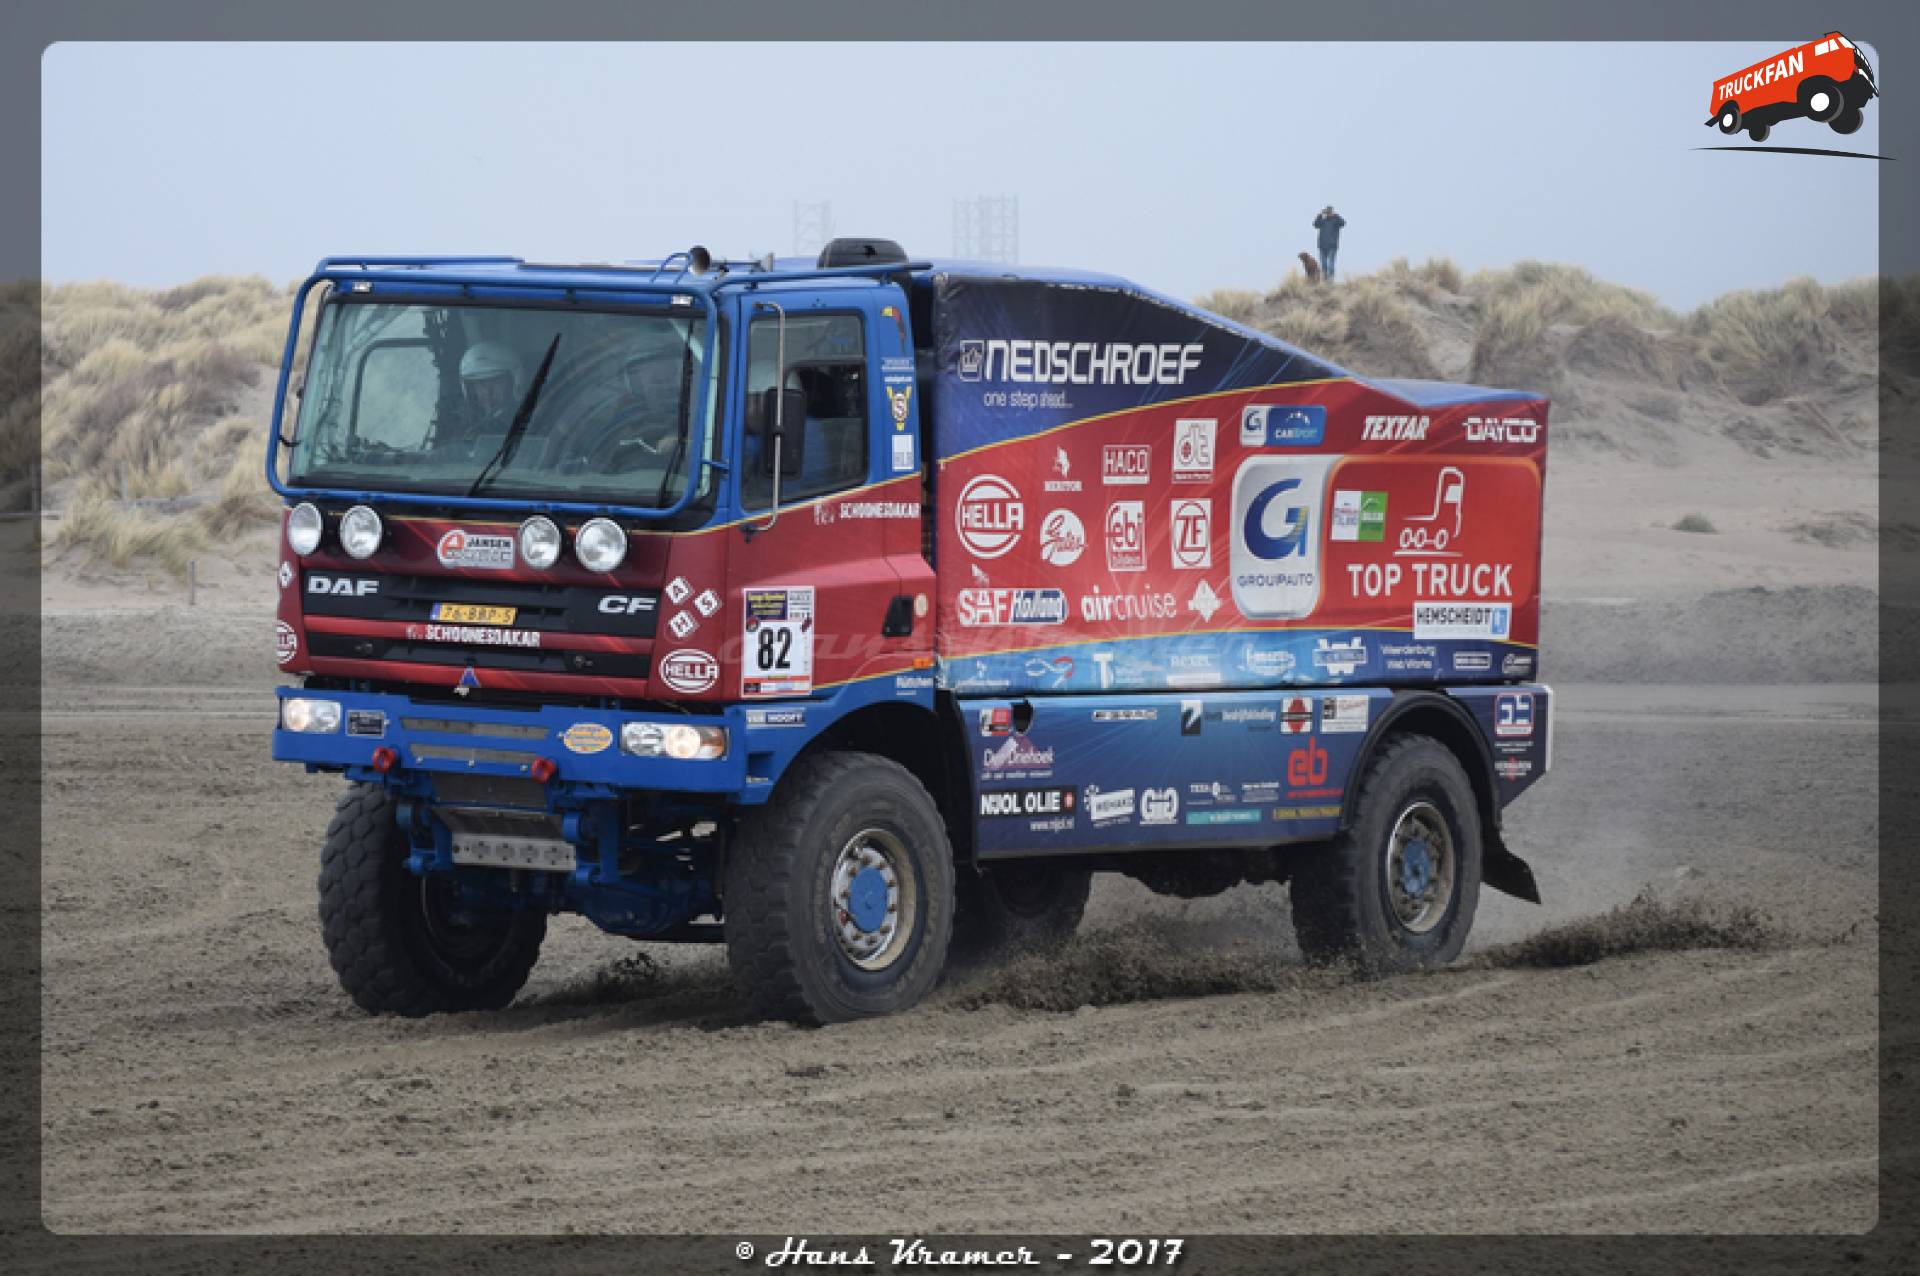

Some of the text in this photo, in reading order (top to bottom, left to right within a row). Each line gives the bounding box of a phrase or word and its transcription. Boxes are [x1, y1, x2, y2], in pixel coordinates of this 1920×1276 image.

[984, 339, 1204, 385] NEDSCHROEF
[1361, 415, 1431, 441] TEXTAR
[1463, 417, 1542, 443] DAYCO
[1105, 450, 1148, 474] HACO
[961, 502, 1024, 531] HELLA
[307, 575, 380, 597] DAF
[1346, 562, 1513, 597] TOP TRUCK
[597, 595, 658, 615] CF
[958, 589, 1009, 625] SAF
[757, 626, 793, 671] 82
[665, 664, 718, 679] HELLA
[1025, 790, 1061, 813] OLIE
